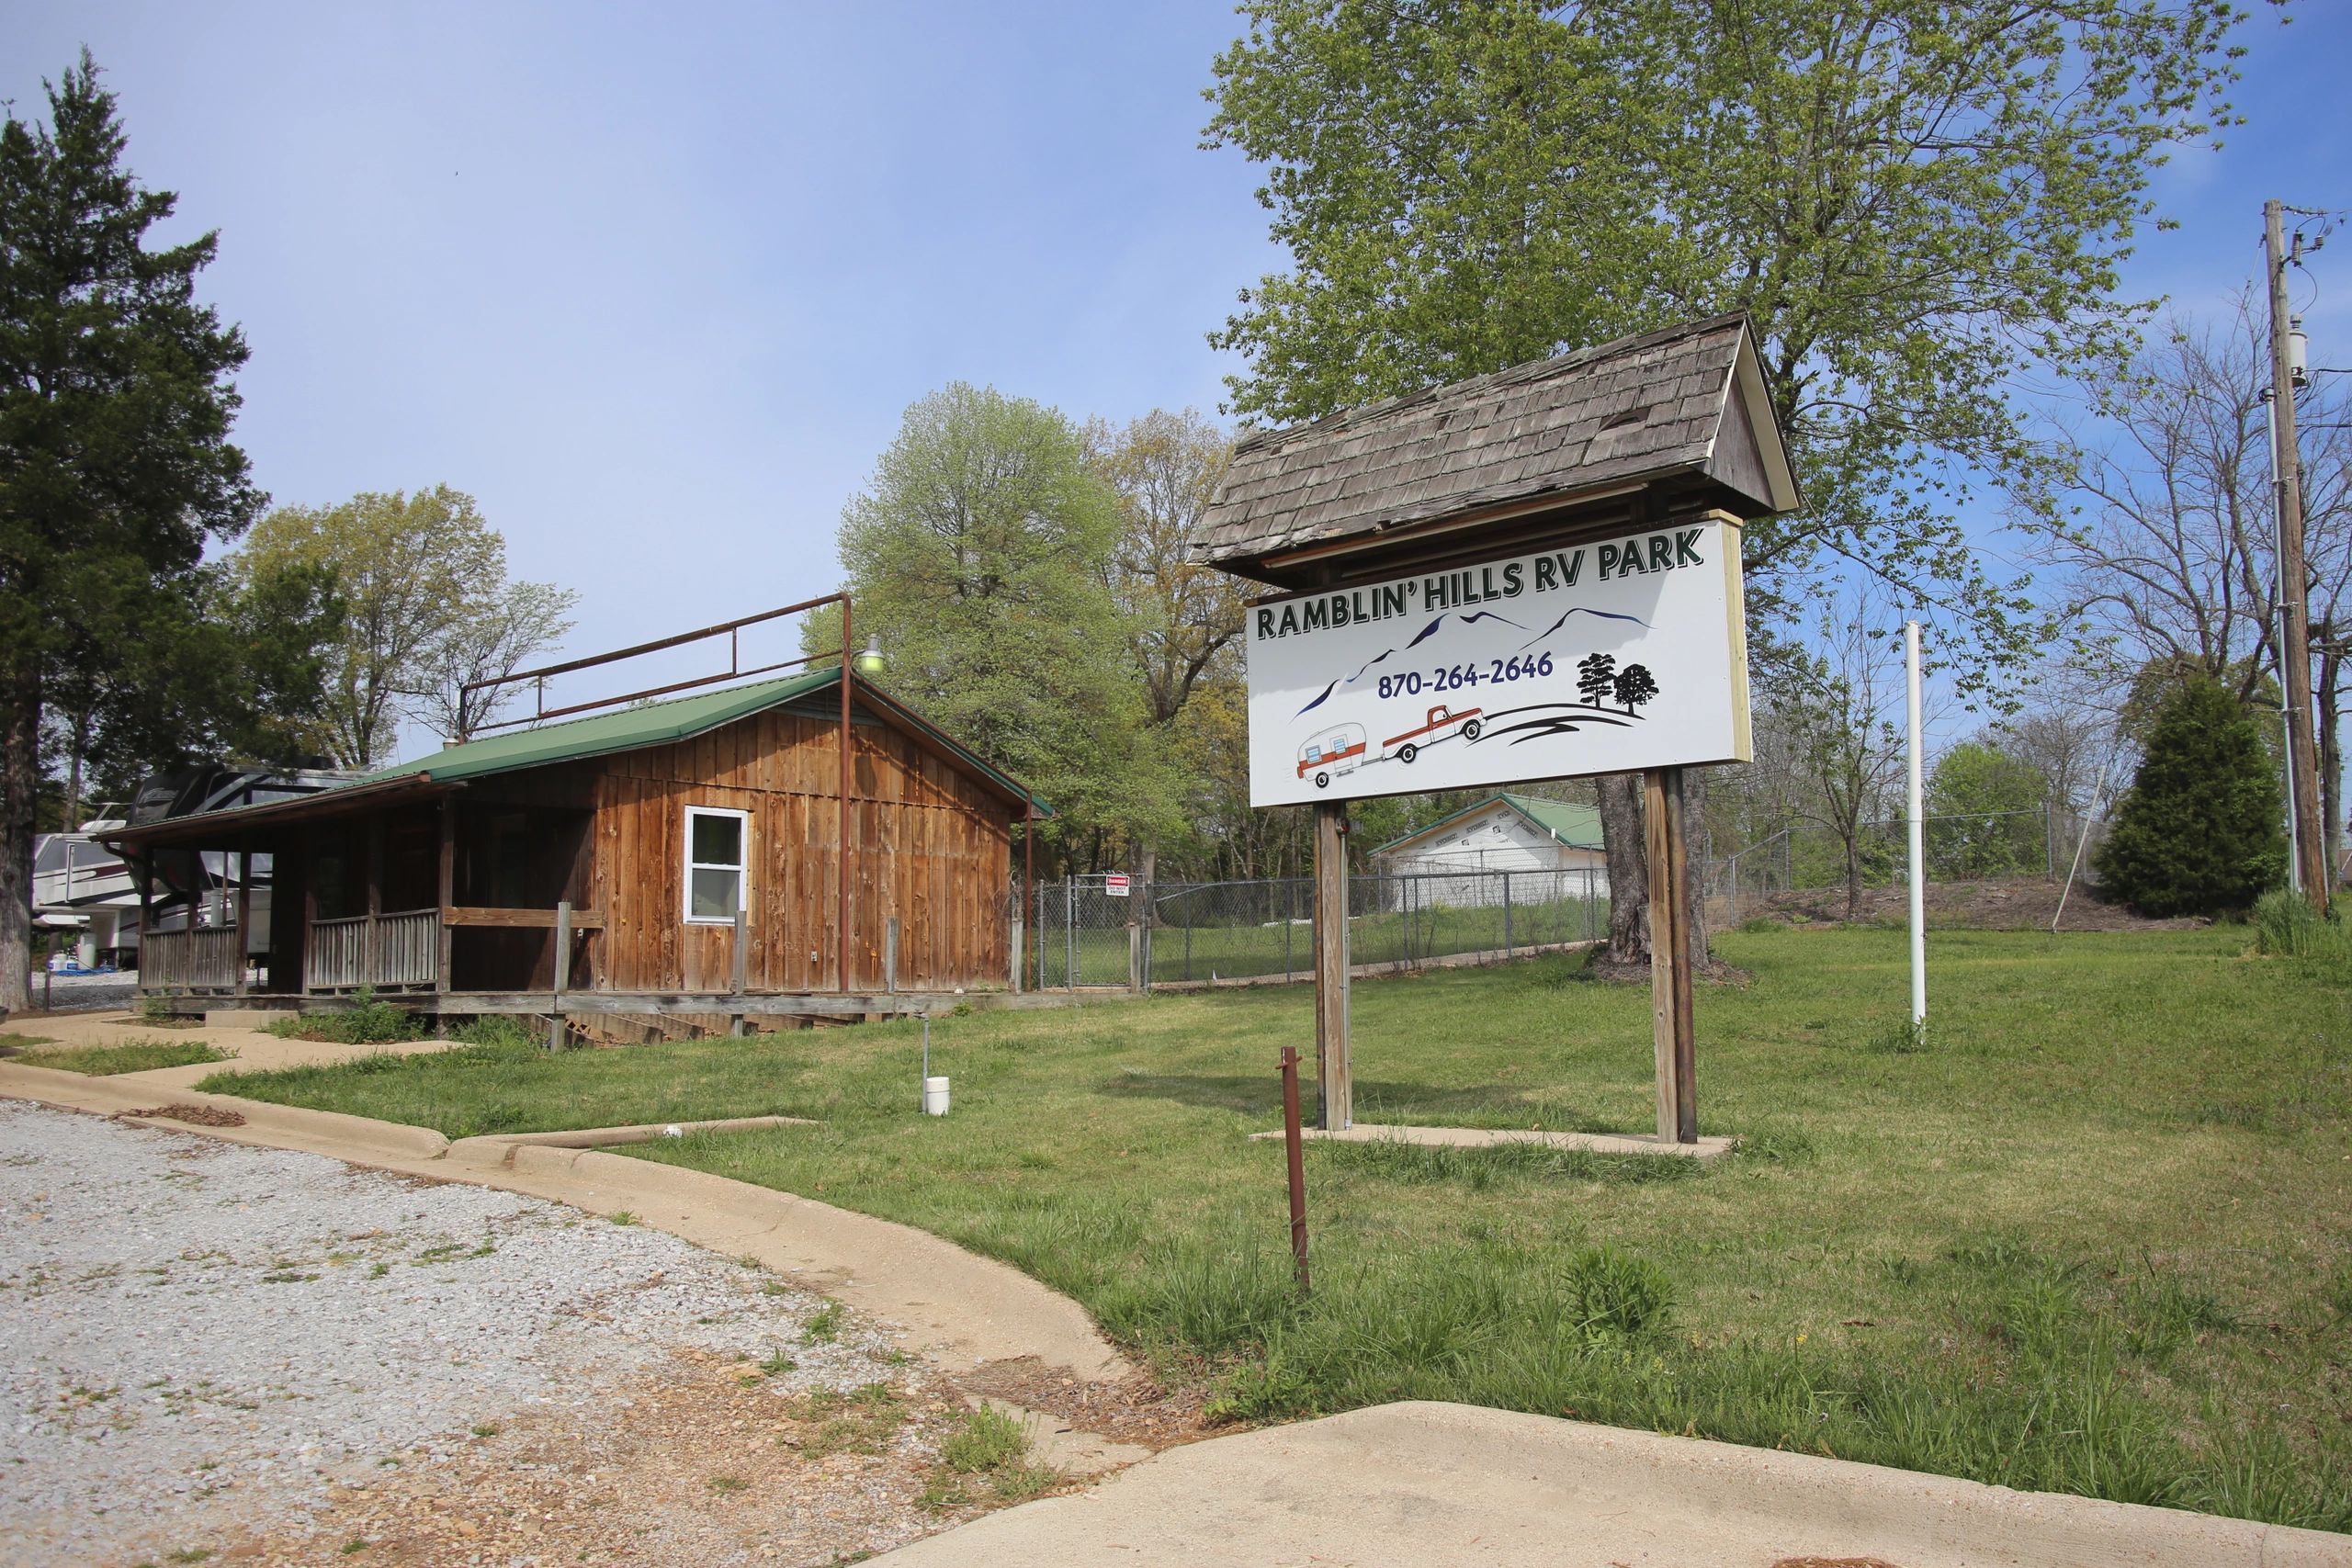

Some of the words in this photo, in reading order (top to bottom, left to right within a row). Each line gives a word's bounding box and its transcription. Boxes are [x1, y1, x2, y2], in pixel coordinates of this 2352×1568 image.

[1258, 581, 1417, 640] RAMBLIN'
[1424, 563, 1524, 612] HILLS
[1533, 550, 1586, 593] RV
[1599, 528, 1704, 581] PARK
[1378, 650, 1553, 698] 870-264-2646
